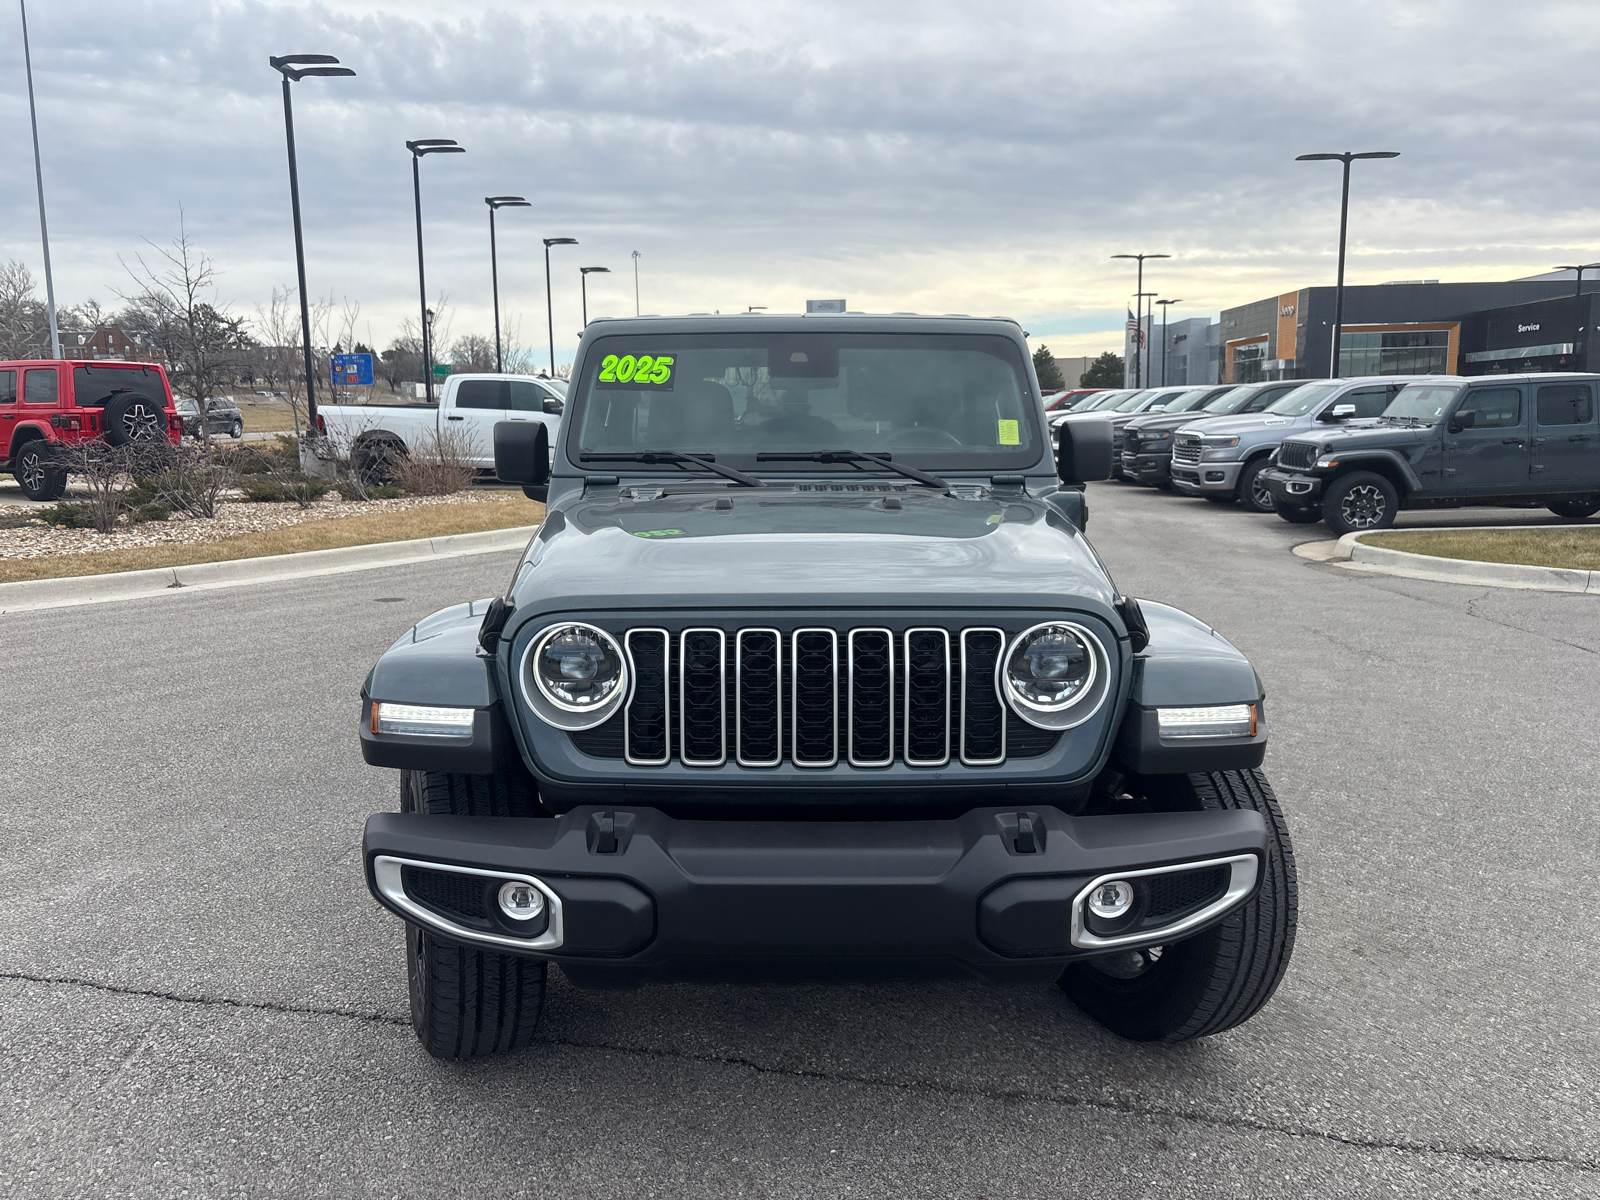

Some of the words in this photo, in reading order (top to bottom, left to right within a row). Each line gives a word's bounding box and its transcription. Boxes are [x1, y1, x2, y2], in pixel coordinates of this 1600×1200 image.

[1280, 305, 1294, 316] Jeep
[1517, 323, 1540, 332] Service
[599, 354, 674, 384] 2025
